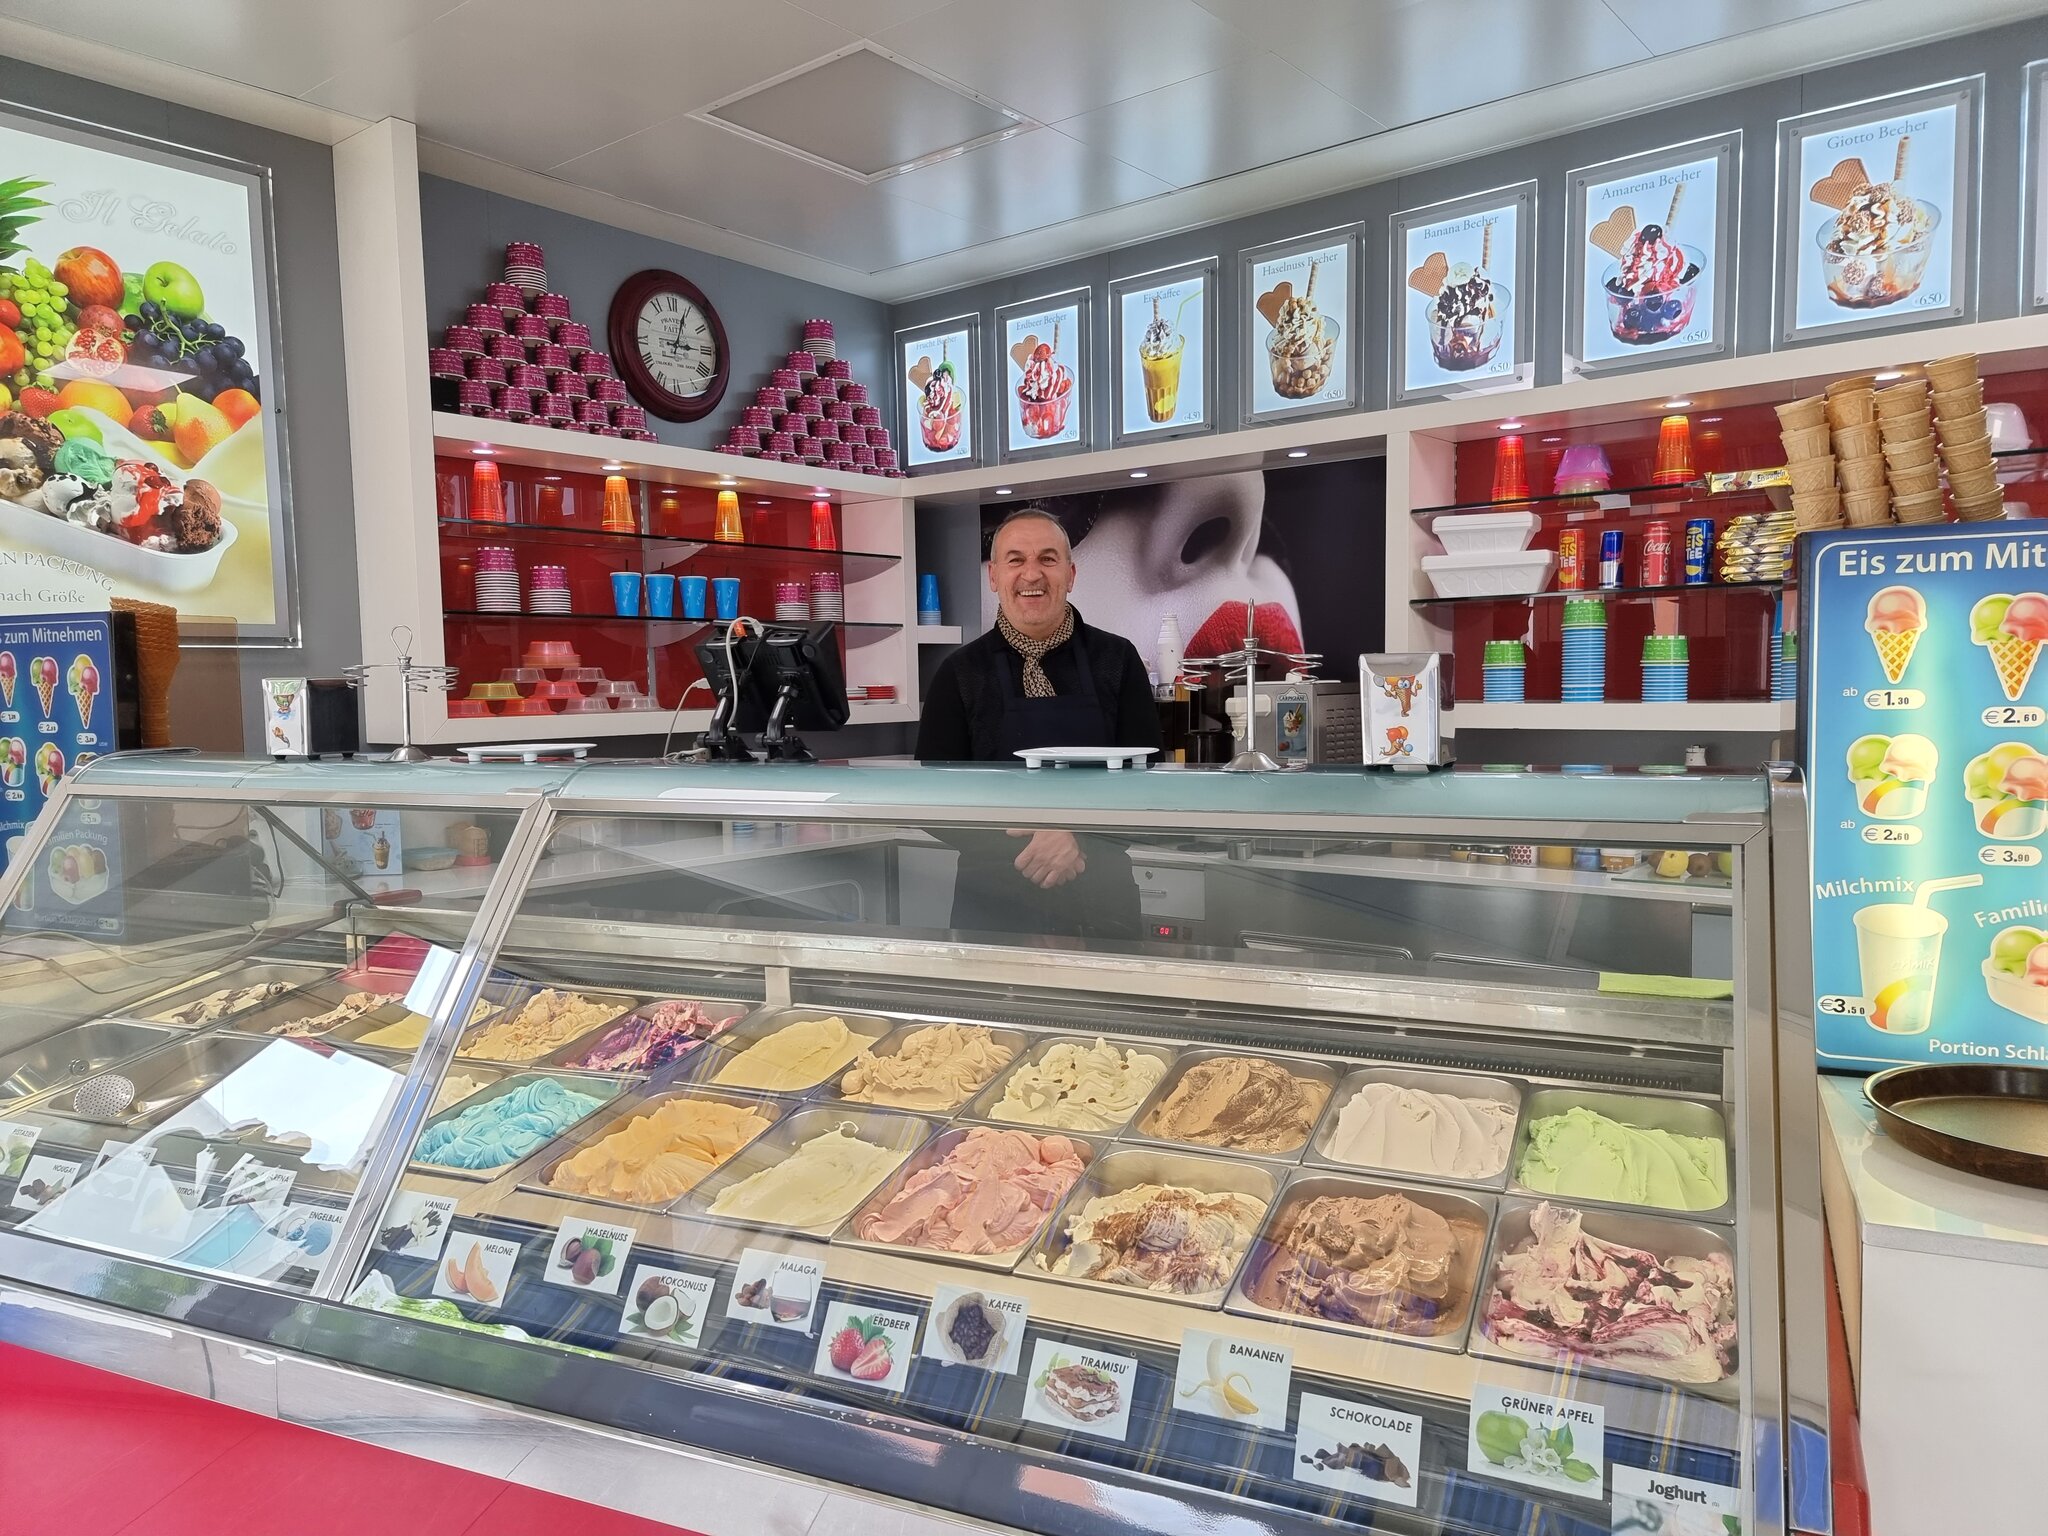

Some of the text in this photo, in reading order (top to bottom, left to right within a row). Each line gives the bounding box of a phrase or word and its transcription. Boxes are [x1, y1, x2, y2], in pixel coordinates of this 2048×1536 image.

[1827, 120, 1929, 150] Giotto Becher
[1601, 168, 1701, 200] Amarena Becher
[1424, 214, 1499, 240] Banana Becher
[1262, 252, 1338, 277] Haselnuss Becher
[1155, 288, 1181, 301] Kaffee
[1839, 541, 2047, 576] Eis zum Mit
[24, 551, 116, 592] PACKUNG
[0, 588, 86, 603] nach Größe
[5, 626, 102, 644] zum Mitnehmen
[1842, 687, 1858, 697] ab
[1840, 819, 1856, 829] ab
[75, 829, 108, 845] Packung
[1816, 876, 1916, 900] Milchmix
[1929, 1038, 2000, 1057] Portion
[53, 1164, 76, 1174] NOUGAT
[424, 1199, 451, 1212] VANILLE
[308, 1211, 344, 1224] ENGELBLAU
[587, 1227, 629, 1242] HASELNUSS
[484, 1243, 514, 1256] MELONE
[779, 1261, 817, 1276] MALAGA
[660, 1275, 708, 1292] KOKOSNUSS
[988, 1298, 1022, 1314] KAFFEE
[872, 1315, 911, 1331] ERDBEER
[1229, 1343, 1285, 1364] BANANEN
[1501, 1396, 1595, 1425] GRÜNER APFEL
[1330, 1406, 1413, 1434] SCHOKOLADE
[1648, 1480, 1707, 1506] Joghurt
